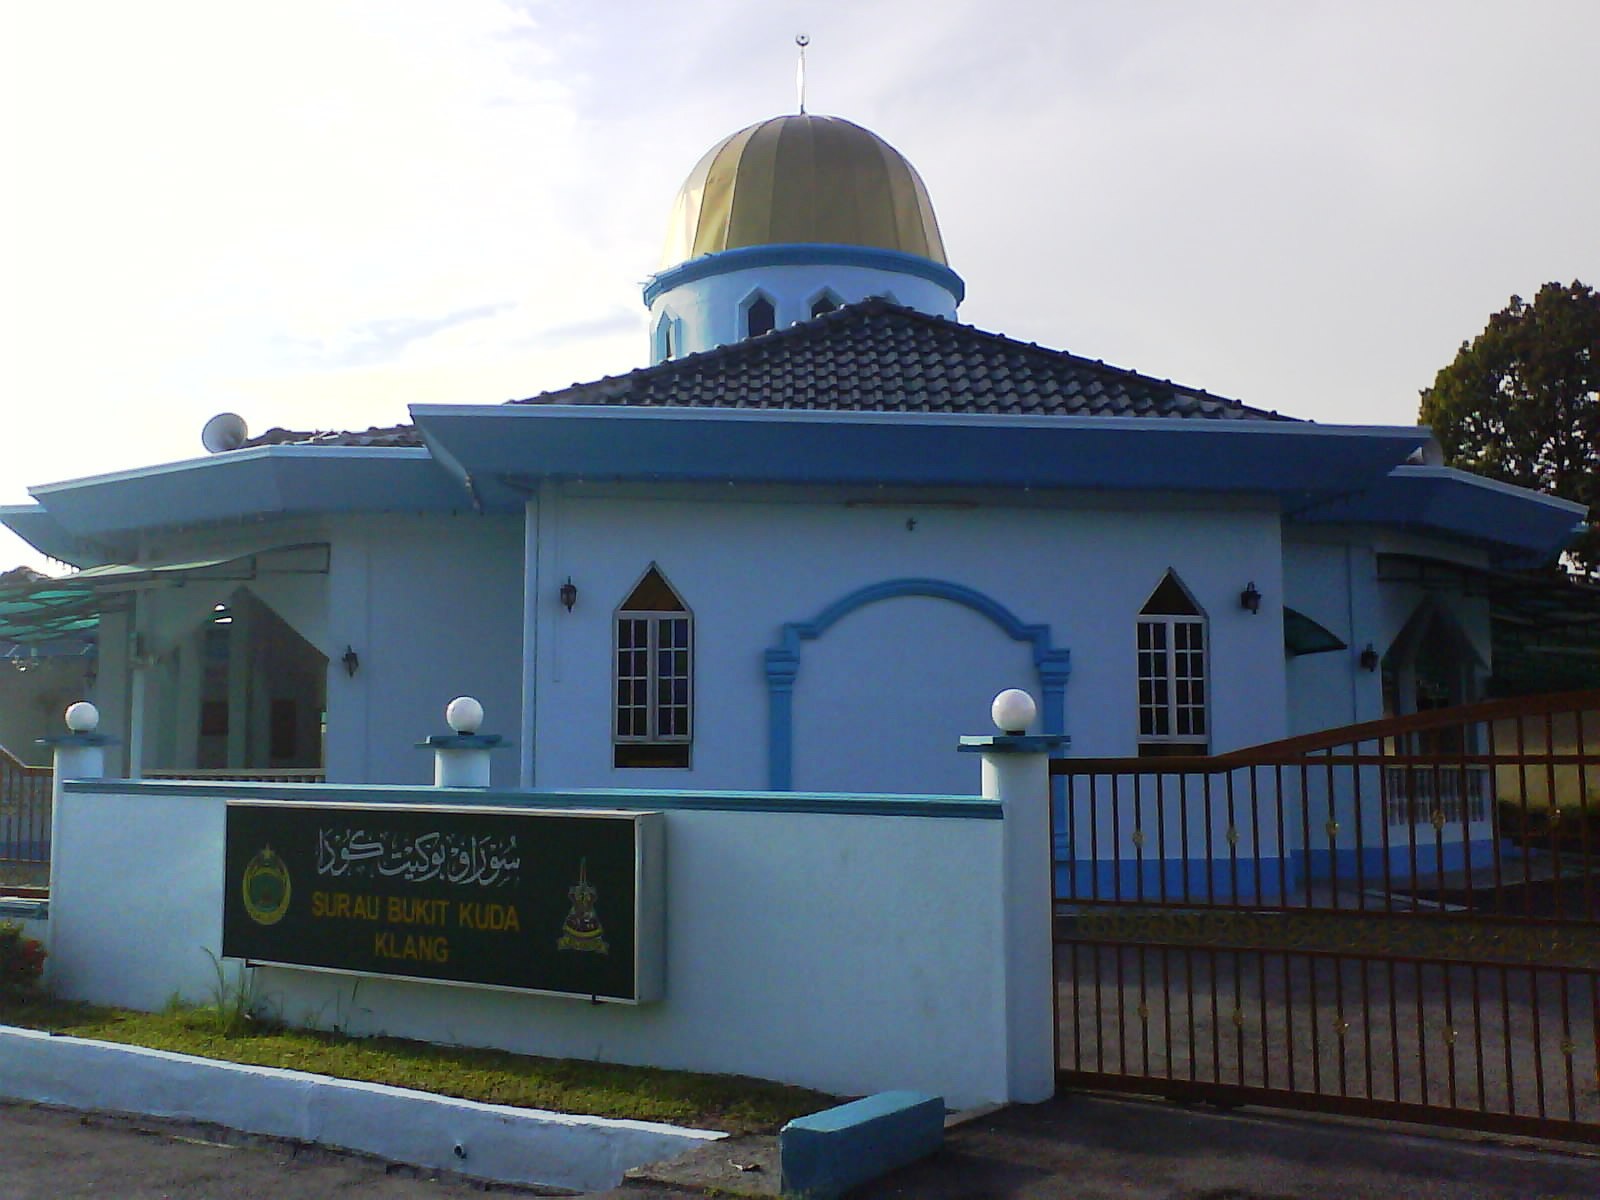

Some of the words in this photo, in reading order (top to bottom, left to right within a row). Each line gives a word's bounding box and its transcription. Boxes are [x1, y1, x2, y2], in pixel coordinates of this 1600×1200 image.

[312, 891, 379, 920] SURAU
[387, 896, 450, 927] BUKIT
[458, 903, 520, 932] KUDA
[375, 932, 449, 962] KLANG
